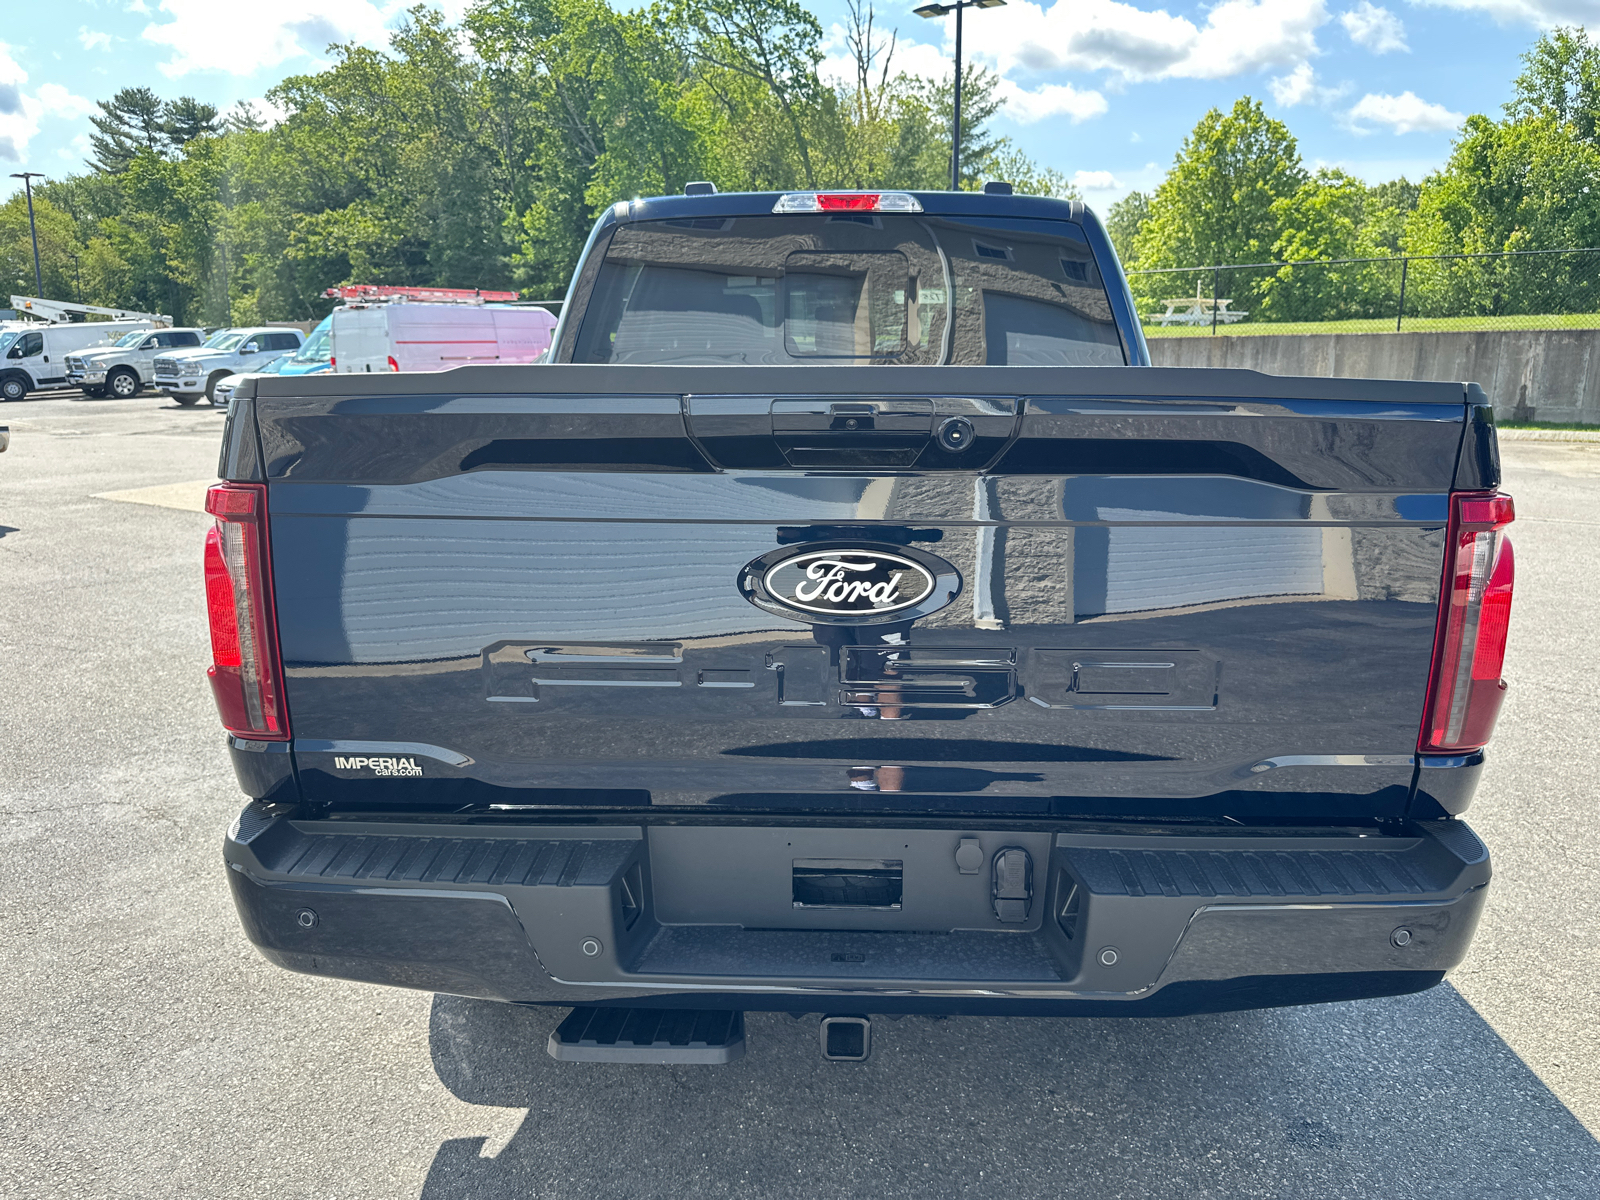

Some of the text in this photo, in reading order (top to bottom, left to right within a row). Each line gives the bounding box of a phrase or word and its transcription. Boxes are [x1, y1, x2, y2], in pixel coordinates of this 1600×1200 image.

[795, 560, 903, 603] Ford
[481, 640, 1221, 711] F-150
[334, 757, 422, 769] IMPERIAL
[374, 768, 423, 776] cars.com
